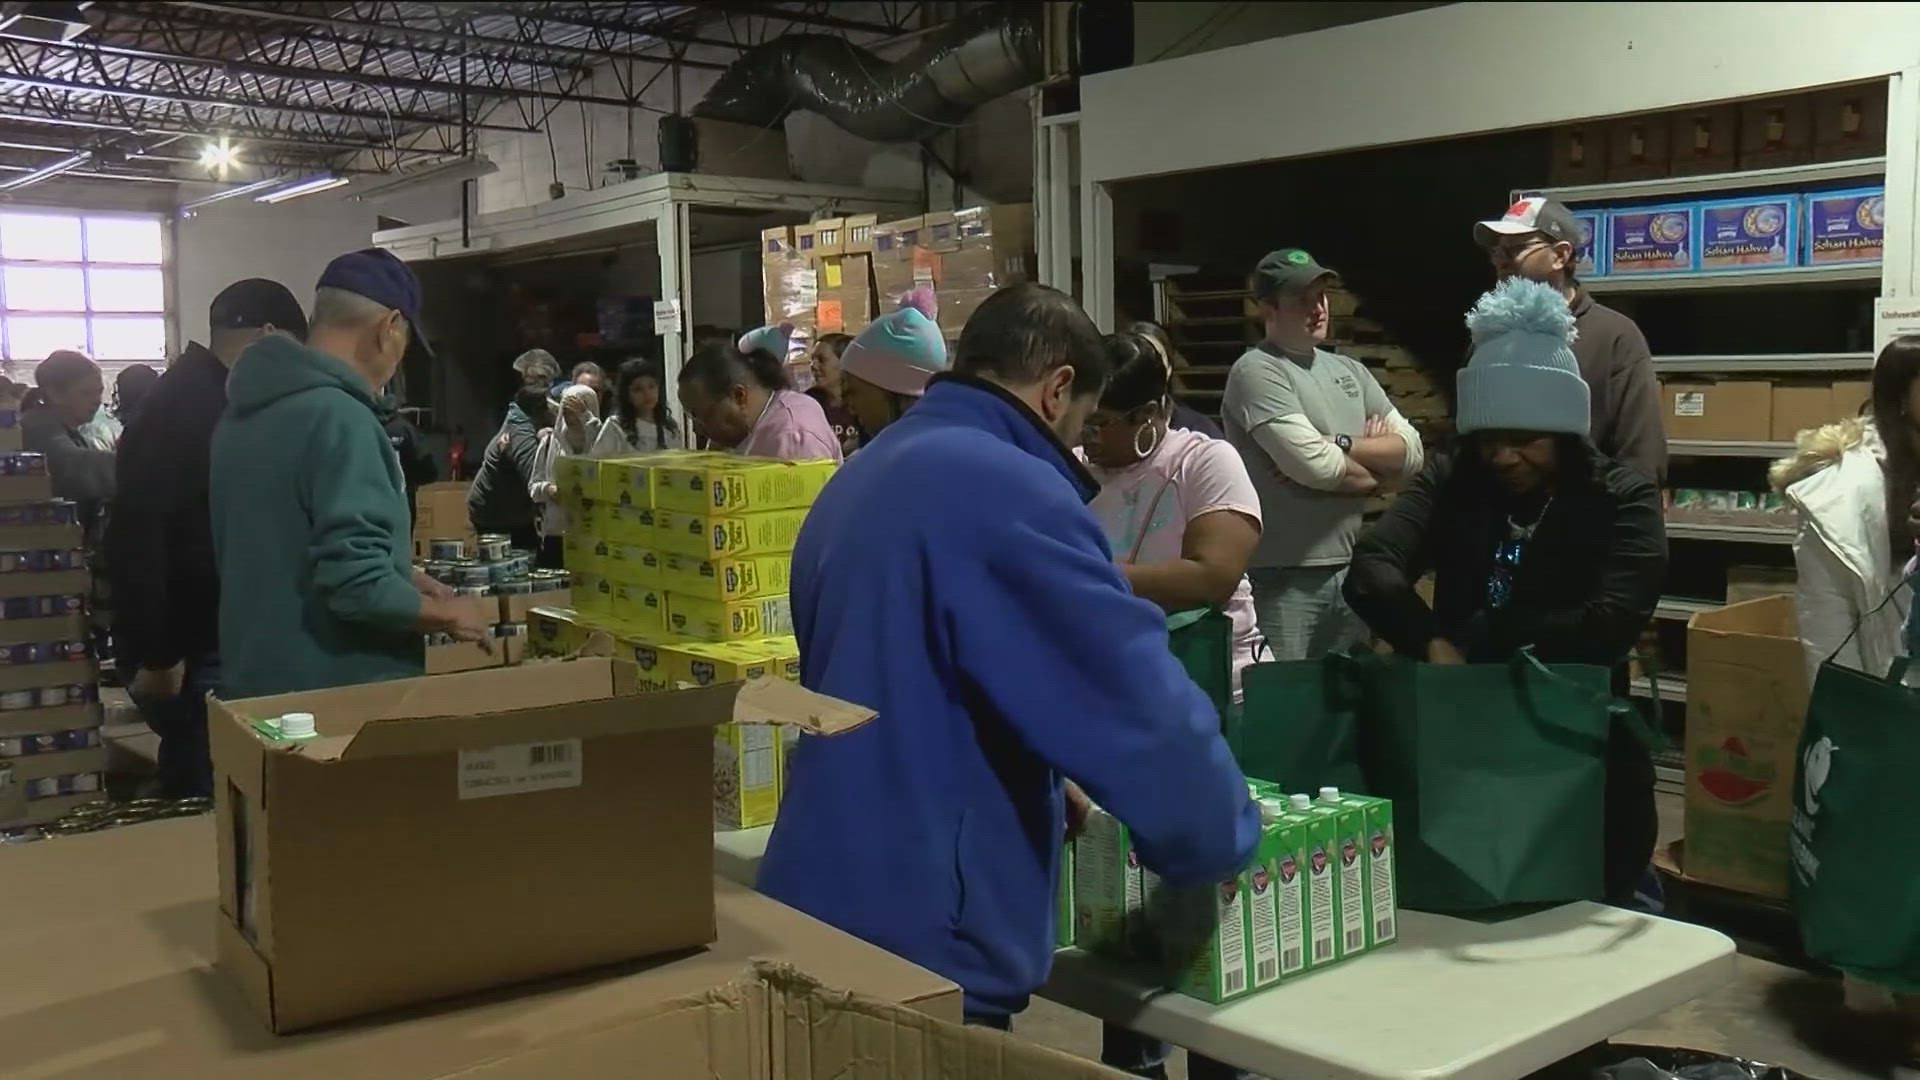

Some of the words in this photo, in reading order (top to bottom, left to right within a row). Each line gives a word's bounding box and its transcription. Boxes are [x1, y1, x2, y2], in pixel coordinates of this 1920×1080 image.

[1704, 246, 1735, 257] Sohan
[1736, 243, 1769, 255] Halva
[1814, 239, 1847, 251] Sohan
